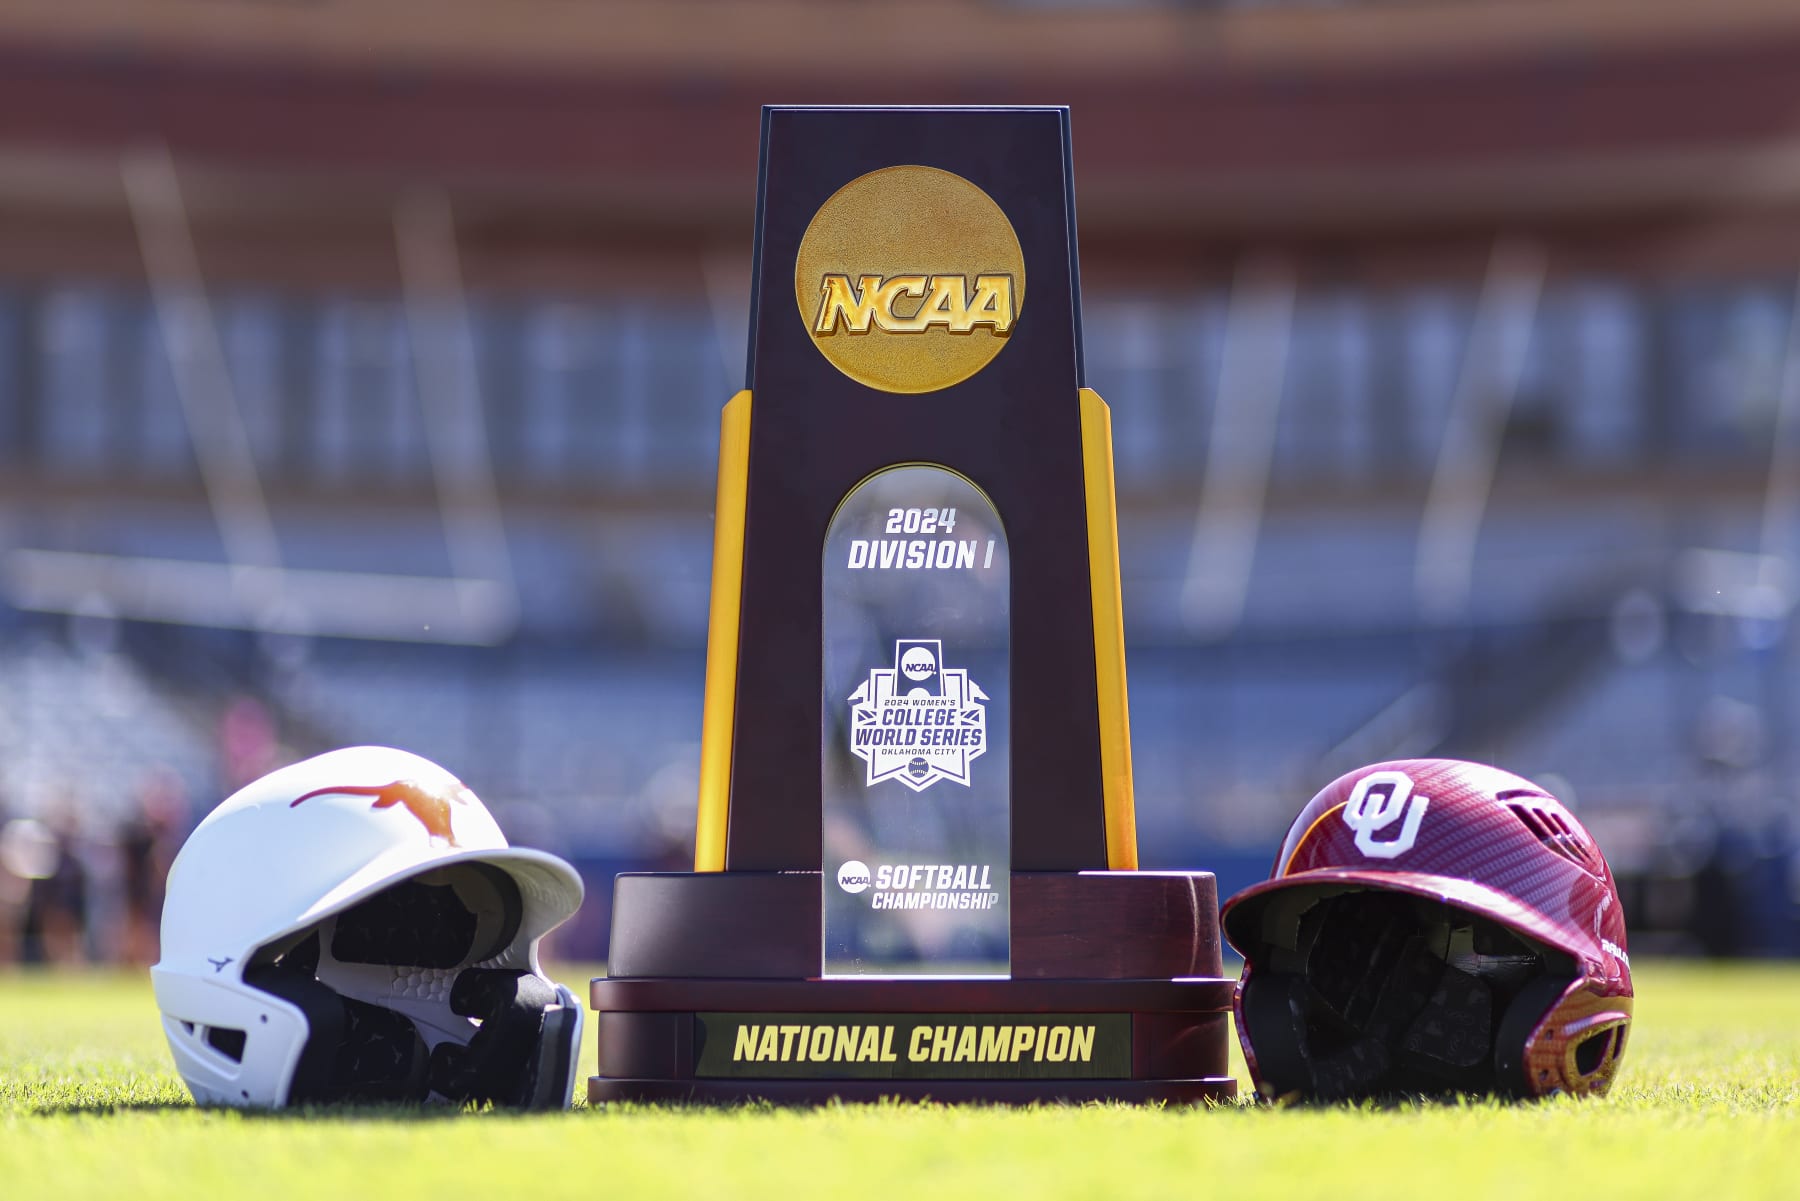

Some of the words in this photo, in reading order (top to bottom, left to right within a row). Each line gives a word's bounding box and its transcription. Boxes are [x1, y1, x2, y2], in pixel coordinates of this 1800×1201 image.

[815, 273, 1018, 337] NCAA
[885, 508, 956, 534] 2024
[848, 540, 977, 568] DIVISION
[983, 540, 996, 568] I
[905, 663, 935, 672] NCAA
[882, 709, 957, 726] COLLEGE
[856, 729, 917, 746] WORLD
[920, 729, 983, 746] SERIES
[1342, 771, 1430, 859] OU
[841, 876, 869, 885] NCAA
[875, 865, 992, 890] SOFTBALL
[872, 892, 999, 910] CHAMPIONSHIP
[733, 1025, 897, 1062] NATIONAL
[907, 1025, 1096, 1063] CHAMPION
